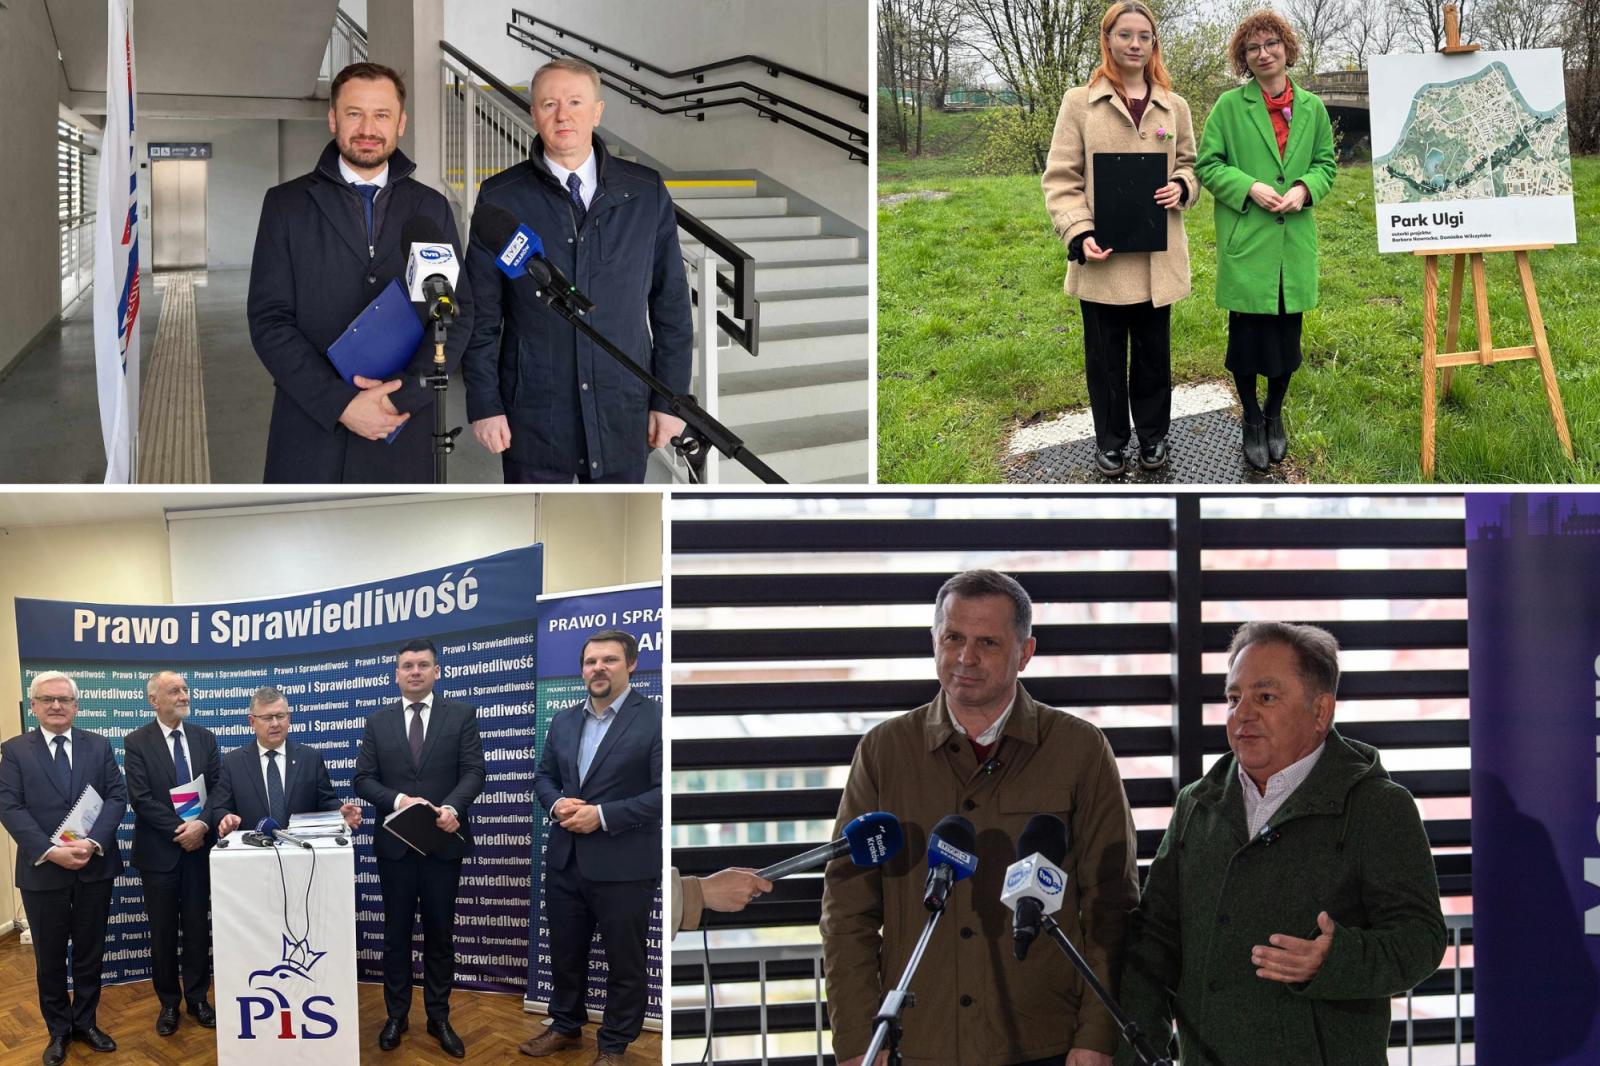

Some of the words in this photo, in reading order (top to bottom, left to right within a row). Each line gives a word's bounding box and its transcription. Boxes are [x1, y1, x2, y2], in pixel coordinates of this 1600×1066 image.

[190, 147, 197, 157] 2
[1391, 213, 1428, 227] Park
[1432, 211, 1464, 228] Ulgi
[73, 609, 179, 644] Prawo
[191, 612, 200, 644] i
[210, 567, 479, 647] Sprawiedliwość
[548, 613, 607, 632] PRAWO
[612, 612, 617, 625] I
[442, 645, 466, 654] Prawo
[472, 633, 534, 651] Sprawiedliwość
[274, 667, 293, 675] Prawo
[299, 661, 349, 674] Sprawiedliwość
[355, 657, 376, 667] Prawo
[444, 655, 534, 678] Sprawiedliwość
[112, 671, 132, 679] Prawo
[219, 667, 268, 680] Sprawiedliwość
[313, 673, 390, 694] Sprawiedliwość
[443, 689, 467, 698] Prawo
[473, 681, 535, 695] Sprawiedliwość
[299, 700, 349, 711] Sprawiedliwość
[355, 698, 376, 707] Prawo
[113, 709, 134, 718] Prawo
[195, 708, 214, 716] Prawo
[866, 837, 878, 864] Kraków
[874, 834, 886, 857] Radio
[120, 896, 141, 904] Prawo
[361, 893, 383, 902] Prawo
[363, 931, 384, 940] Prawo
[452, 934, 475, 943] Prawo
[453, 972, 477, 982] Prawo
[235, 995, 339, 1040] PiS
